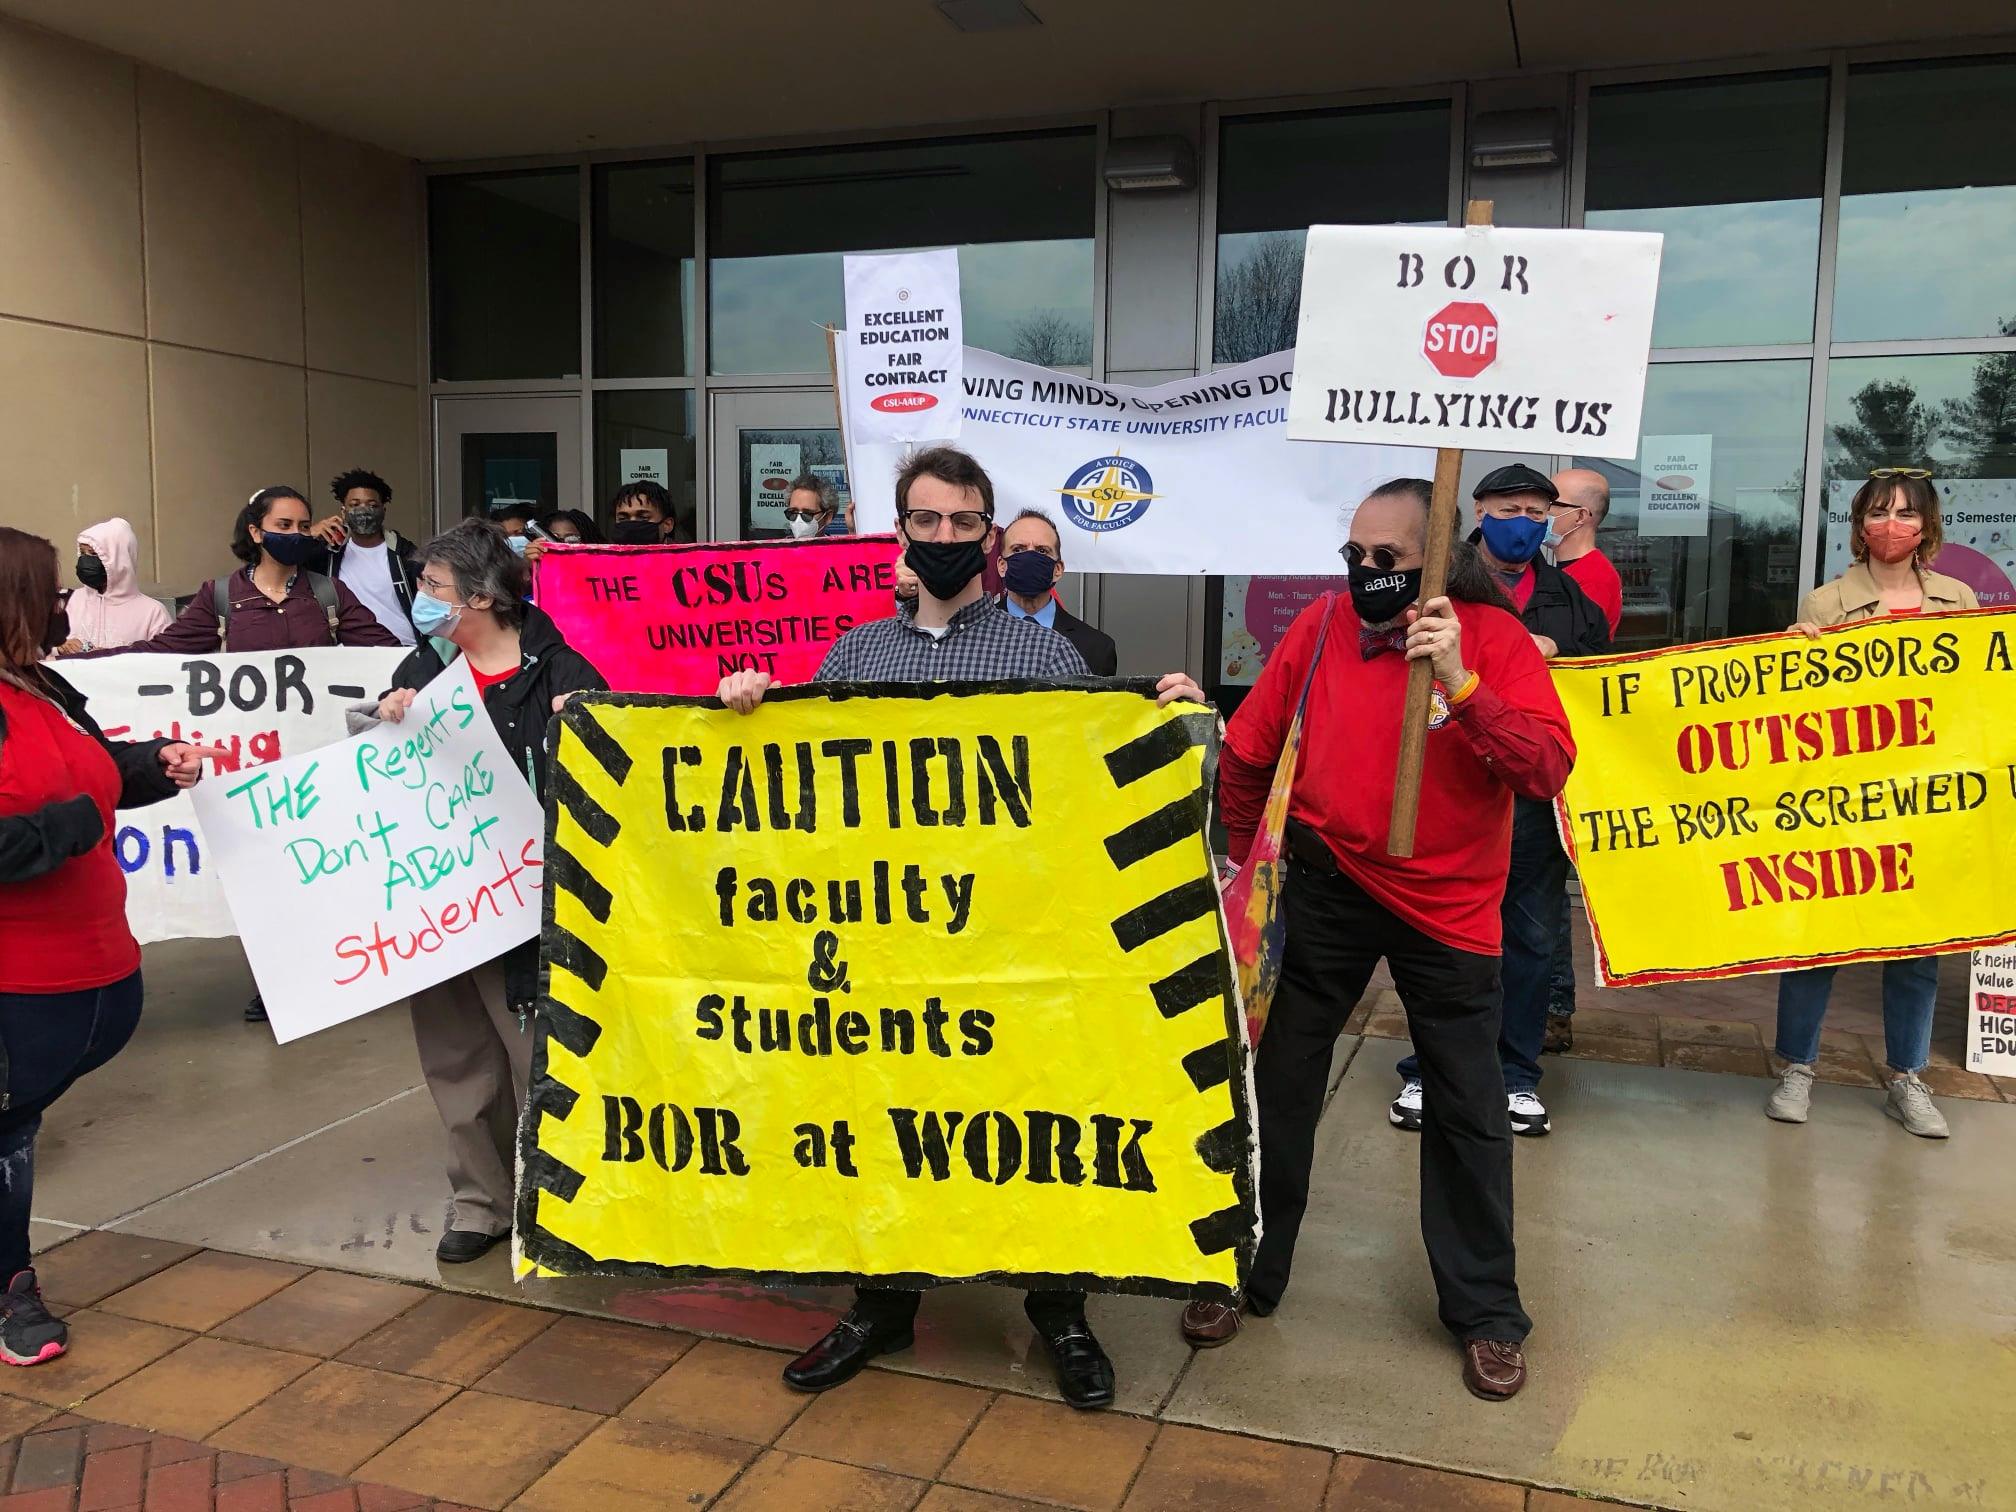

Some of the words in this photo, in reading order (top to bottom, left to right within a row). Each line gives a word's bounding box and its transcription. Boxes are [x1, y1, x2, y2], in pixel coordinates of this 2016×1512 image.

[864, 309, 944, 326] EXCELLENT
[860, 327, 949, 345] EDUCATION
[1427, 323, 1497, 356] STOP
[888, 352, 922, 367] FAIR
[864, 369, 947, 387] CONTRACT
[883, 397, 926, 407] CSU-AAUP
[1031, 381, 1126, 412] MINDS,
[1131, 379, 1251, 413] OPENING
[962, 407, 1064, 429] NNECTICUT
[1066, 417, 1121, 432] STATE
[1126, 415, 1229, 435] UNIVERSITY
[1325, 388, 1540, 430] BULLYING
[1555, 399, 1613, 437] US
[1105, 459, 1136, 470] VOICE
[1091, 488, 1125, 500] CSU
[1647, 502, 1700, 511] EDUCATION
[1650, 493, 1698, 501] EXCELLENT
[1073, 514, 1090, 528] FOR
[1091, 515, 1132, 530] FACULTY
[1957, 511, 2016, 523] Semester
[586, 575, 640, 602] THE
[822, 563, 894, 592] ARE
[1364, 573, 1407, 593] aaup
[1975, 592, 1995, 603] May
[1998, 591, 2010, 601] 16
[1273, 607, 1294, 616] Friday
[647, 614, 854, 651] UNIVERSITIES
[718, 651, 778, 679] NOT
[1600, 671, 1641, 718] IF
[1671, 632, 1961, 709] PROFESSORS
[1984, 631, 2014, 671] A
[1677, 697, 1936, 775] OUTSIDE
[226, 761, 320, 829] THE
[661, 734, 1033, 833] CAUTION
[284, 811, 399, 885] Don't
[426, 750, 494, 830] CARE
[1580, 807, 1659, 852] THE
[1671, 796, 1758, 842] BOR
[1774, 770, 1987, 831] SCREWED
[1719, 842, 1915, 913] INSIDE
[716, 860, 975, 933] faculty
[808, 930, 851, 993] &
[1972, 950, 1982, 966] &
[696, 993, 995, 1058] students
[1980, 1015, 2016, 1036] HIG
[600, 1095, 751, 1177] BOR
[793, 1118, 858, 1177] at
[888, 1107, 1157, 1194] WORK
